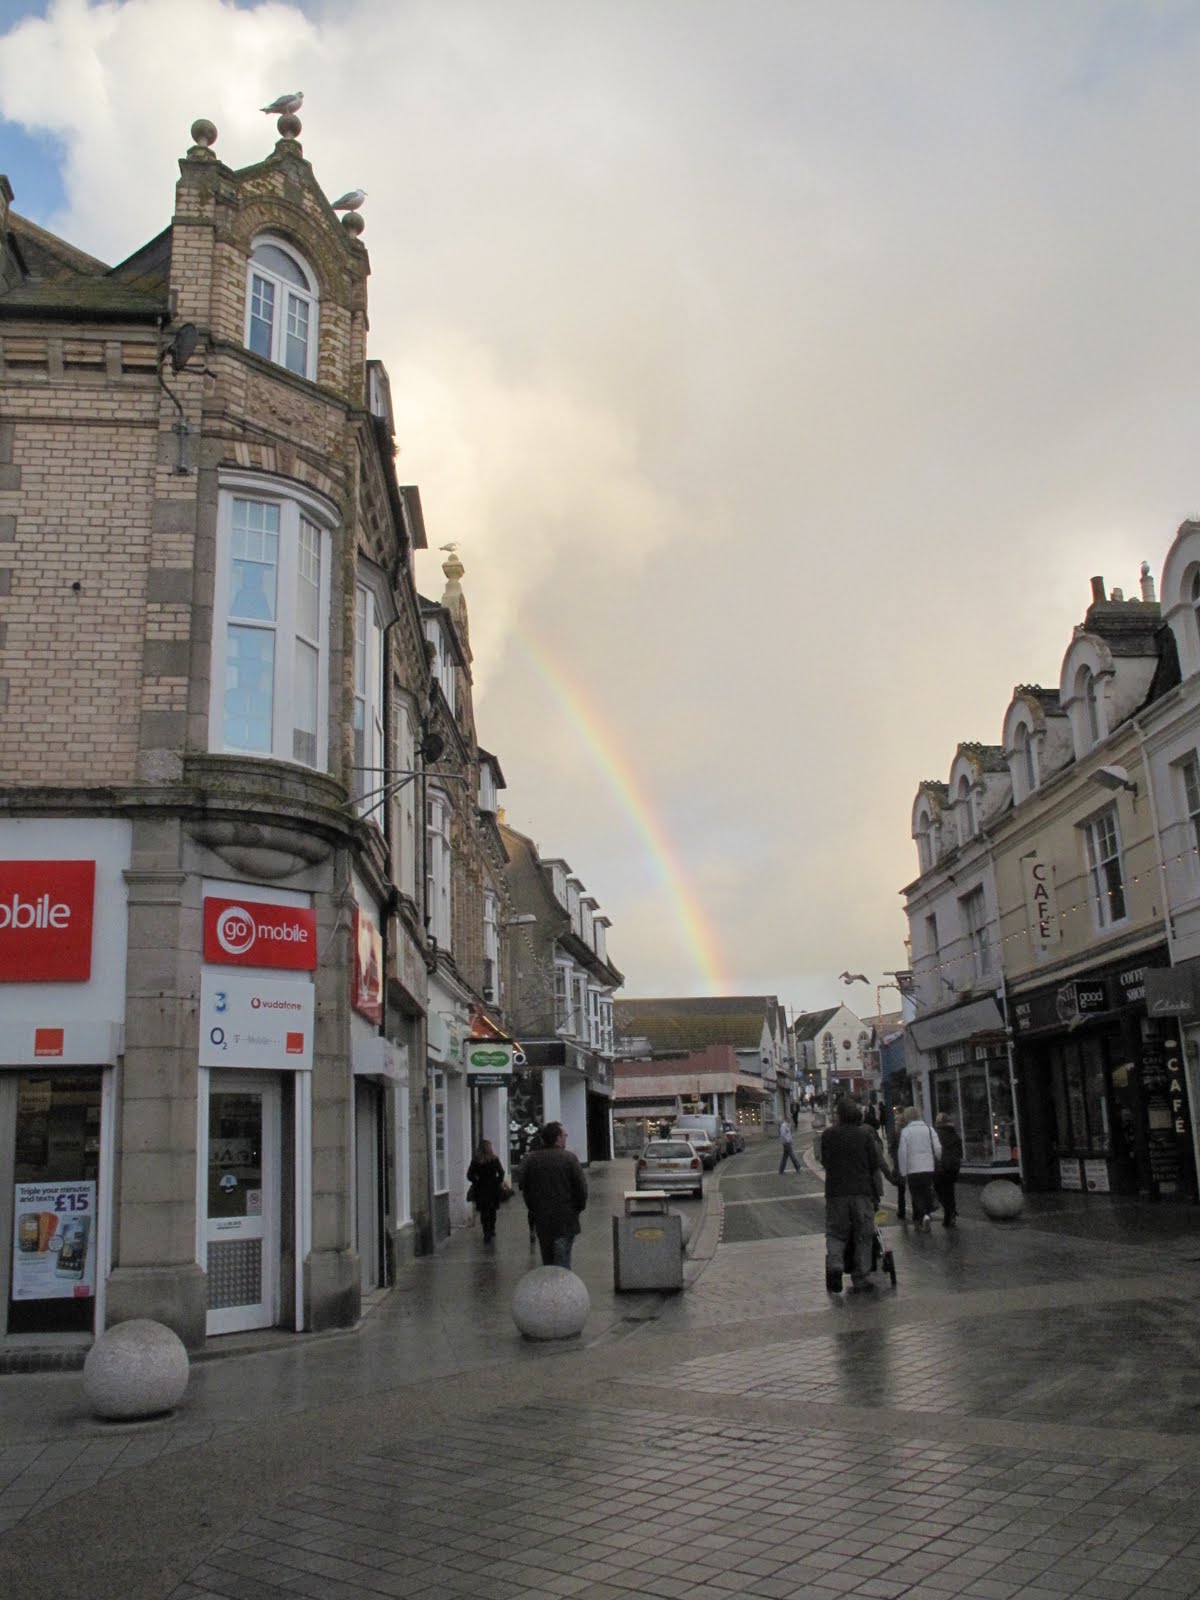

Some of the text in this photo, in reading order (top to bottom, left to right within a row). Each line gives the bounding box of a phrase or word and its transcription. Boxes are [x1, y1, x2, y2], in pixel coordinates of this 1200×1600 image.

[225, 921, 308, 943] go mobile
[215, 992, 226, 1013] 3
[262, 1000, 302, 1010] vodafone
[1079, 985, 1103, 1008] good
[20, 1187, 41, 1195] Triple
[42, 1187, 59, 1195] your
[54, 1193, 89, 1212] £15
